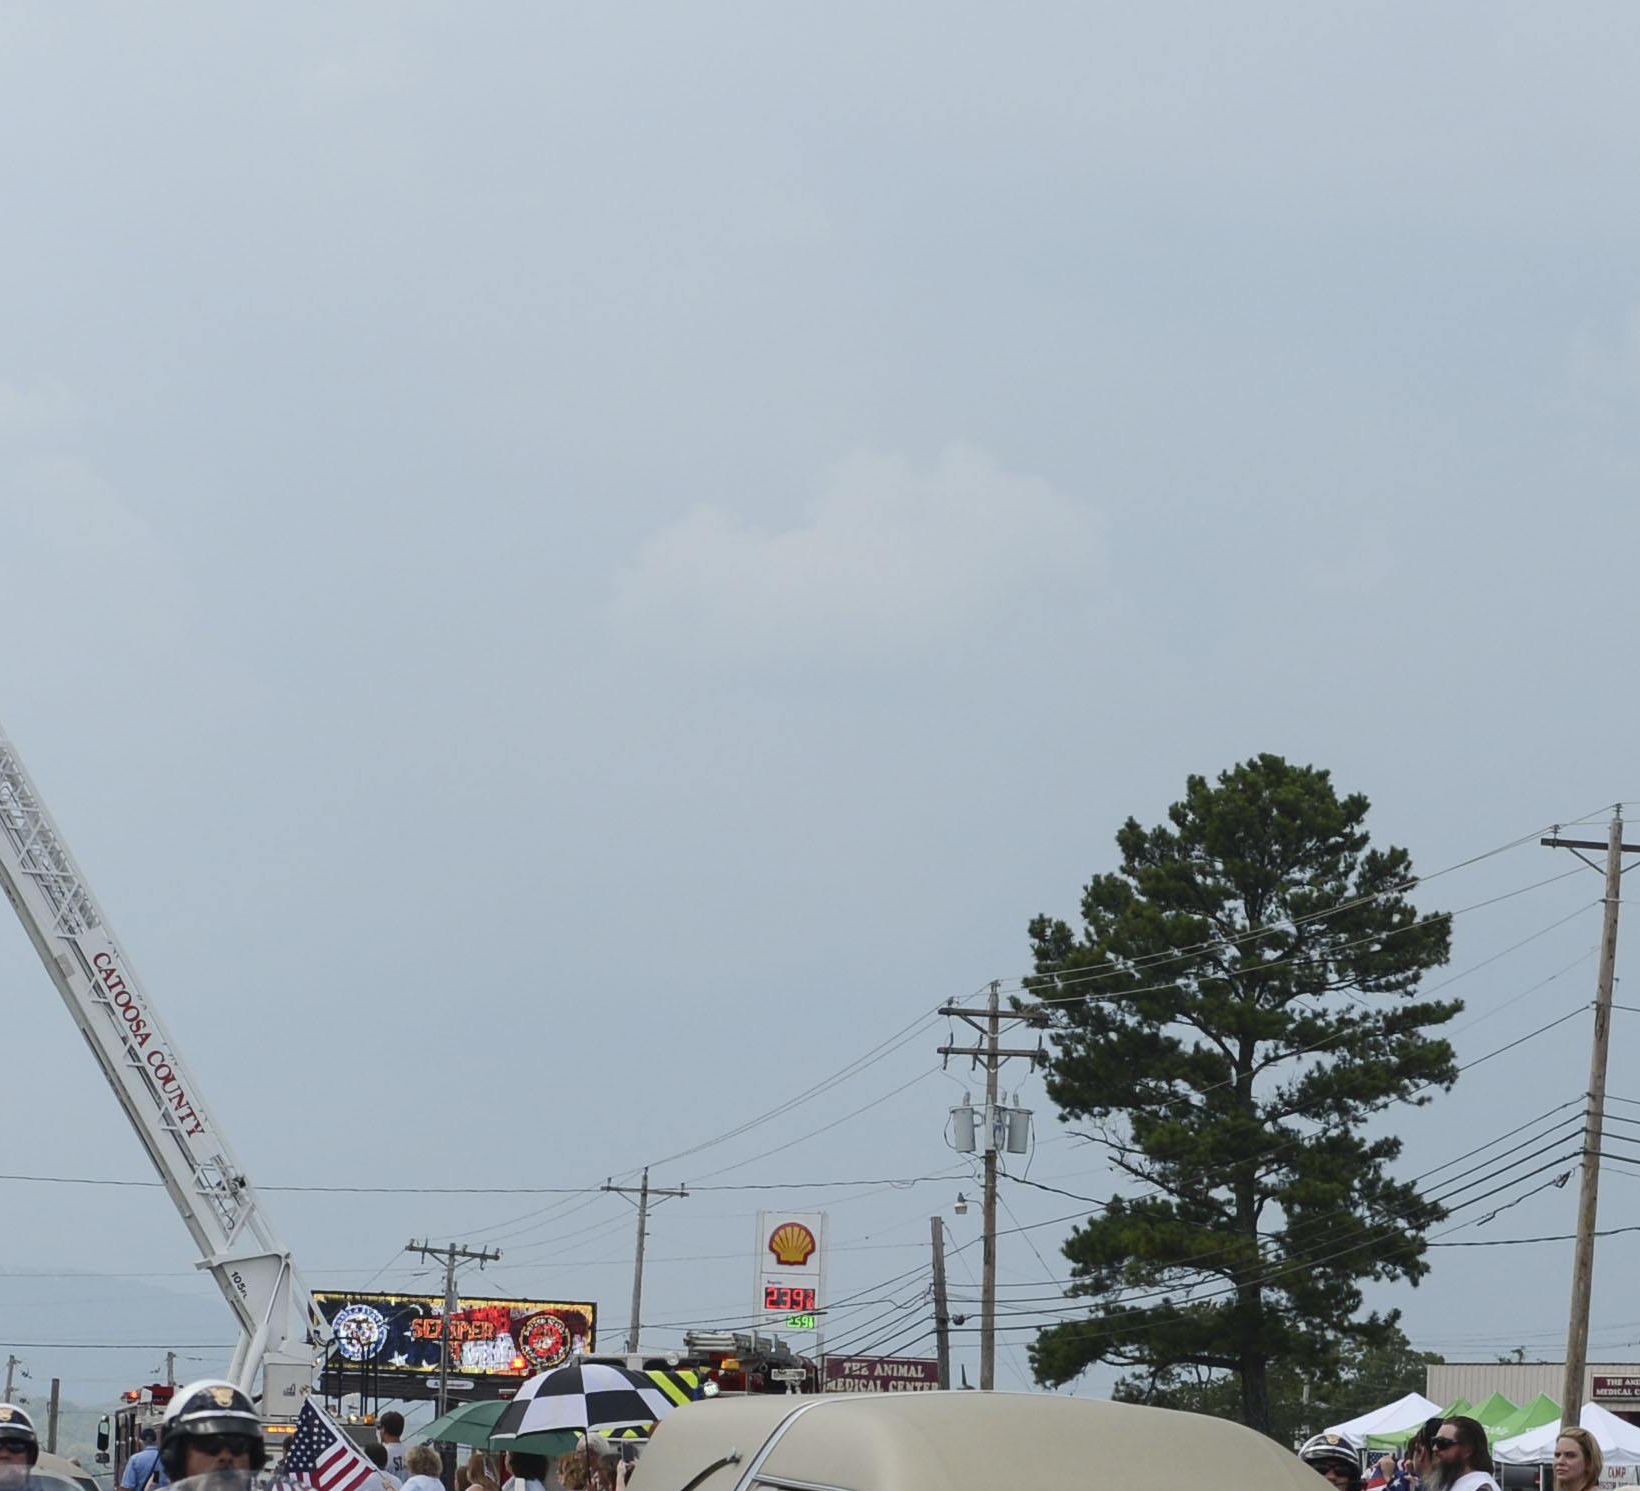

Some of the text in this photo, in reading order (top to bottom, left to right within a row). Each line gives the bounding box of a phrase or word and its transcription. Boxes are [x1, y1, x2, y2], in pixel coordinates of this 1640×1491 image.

[92, 952, 205, 1138] CATOOSA COUNTY
[843, 1362, 925, 1377] THE ANIMAL
[826, 1378, 939, 1393] MEDICAL CENTER
[1596, 1388, 1633, 1396] MEDICAL
